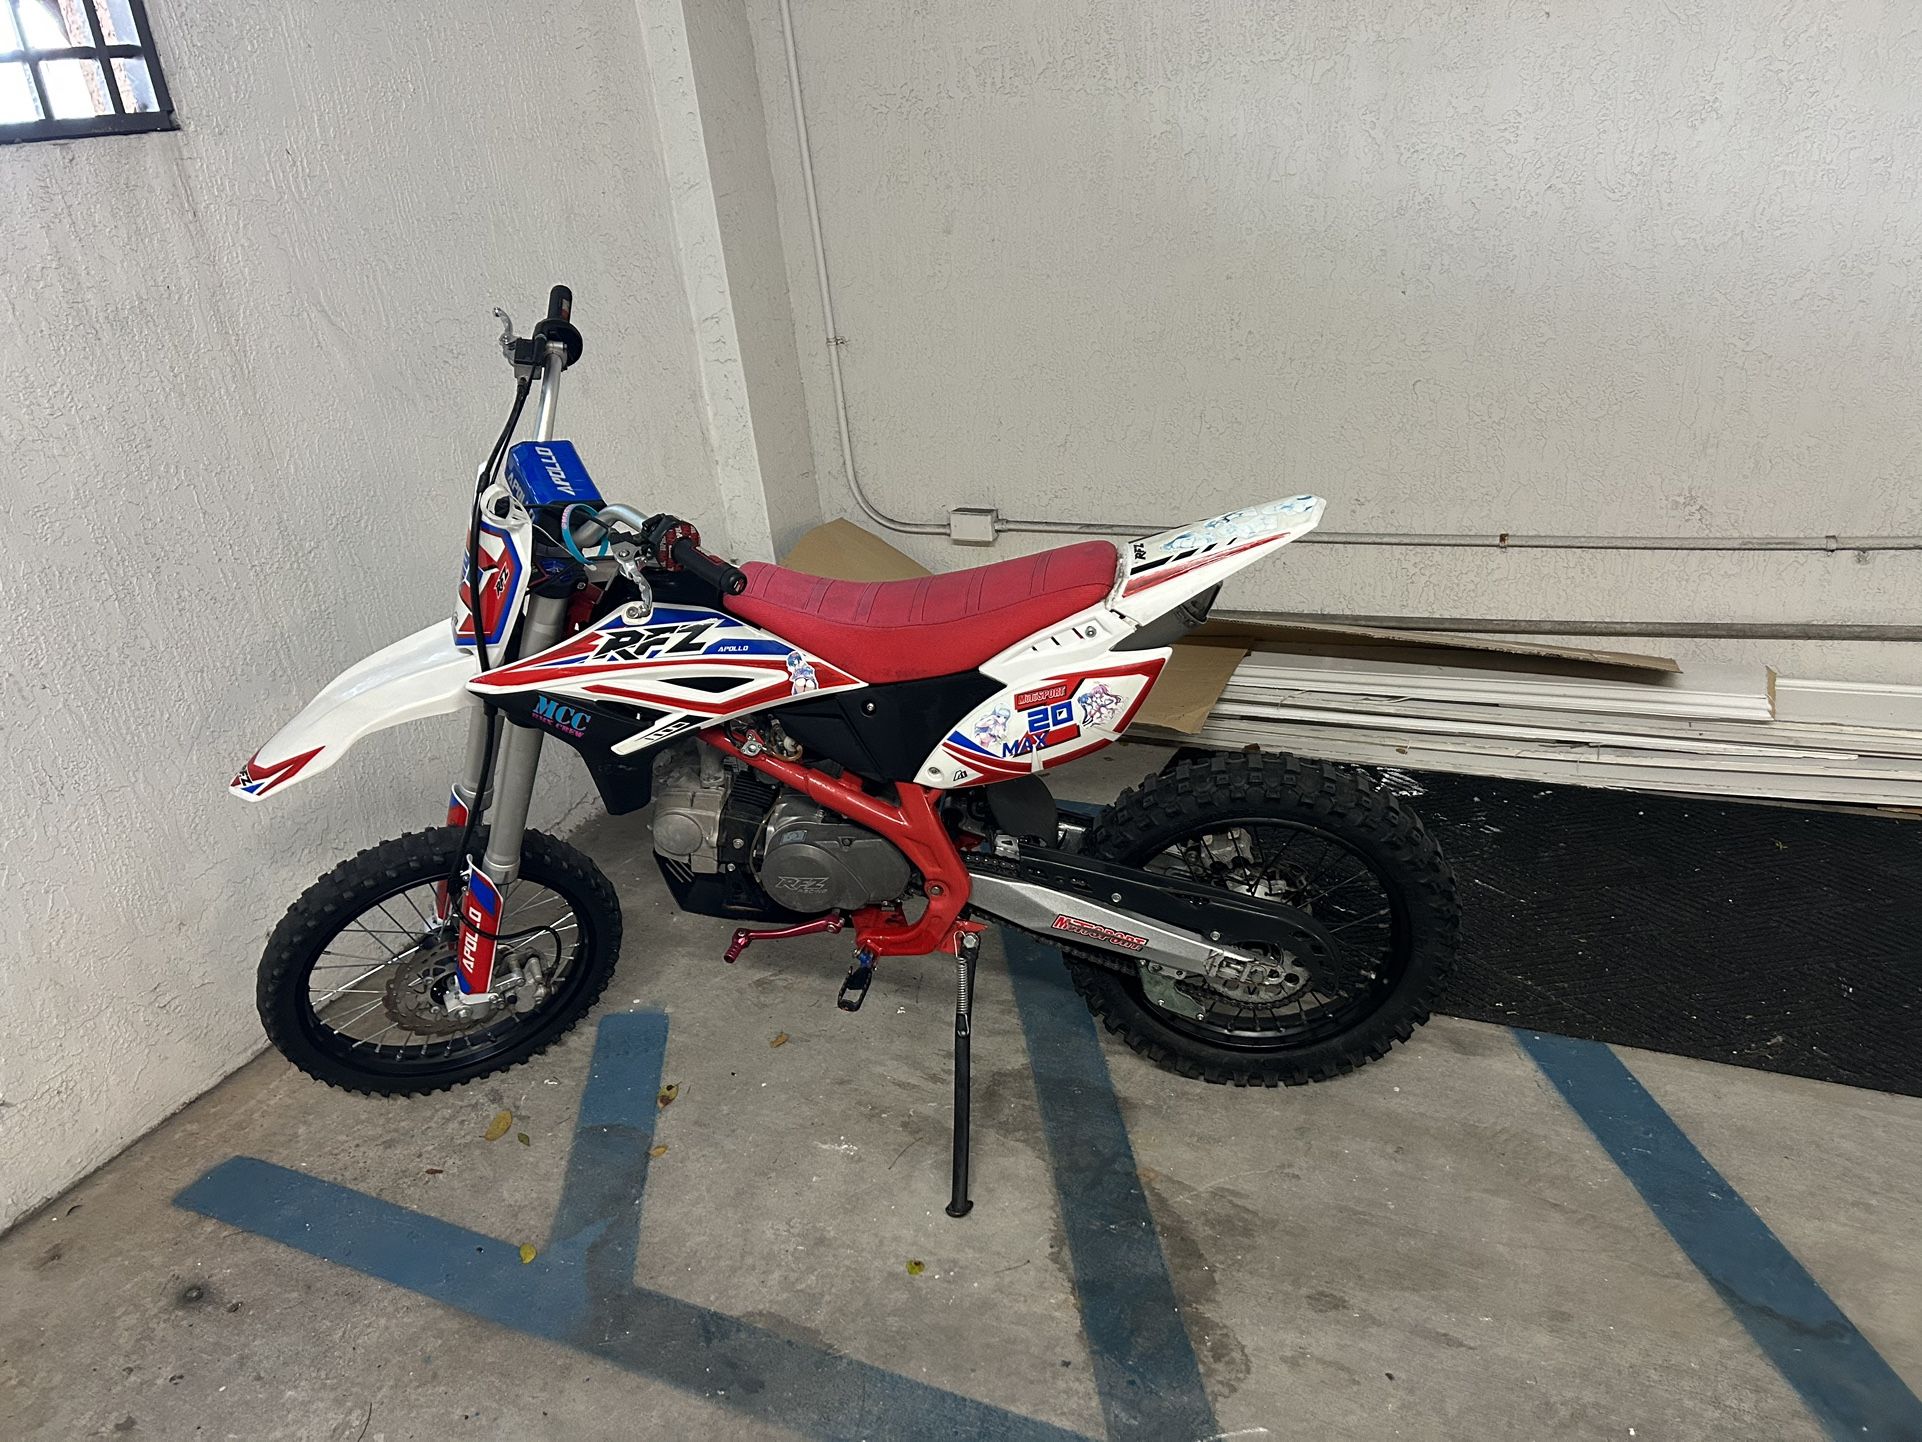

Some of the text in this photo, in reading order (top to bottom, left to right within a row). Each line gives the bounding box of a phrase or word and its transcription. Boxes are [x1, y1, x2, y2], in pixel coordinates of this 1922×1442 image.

[535, 446, 576, 496] APOLLO
[495, 562, 510, 598] RFZ
[592, 619, 717, 661] RFZ
[717, 645, 749, 653] APOLLO
[532, 695, 592, 731] MCC
[1027, 700, 1074, 734] 20
[1002, 729, 1049, 758] MAX
[775, 876, 829, 891] RFZ
[462, 906, 482, 974] APOLO
